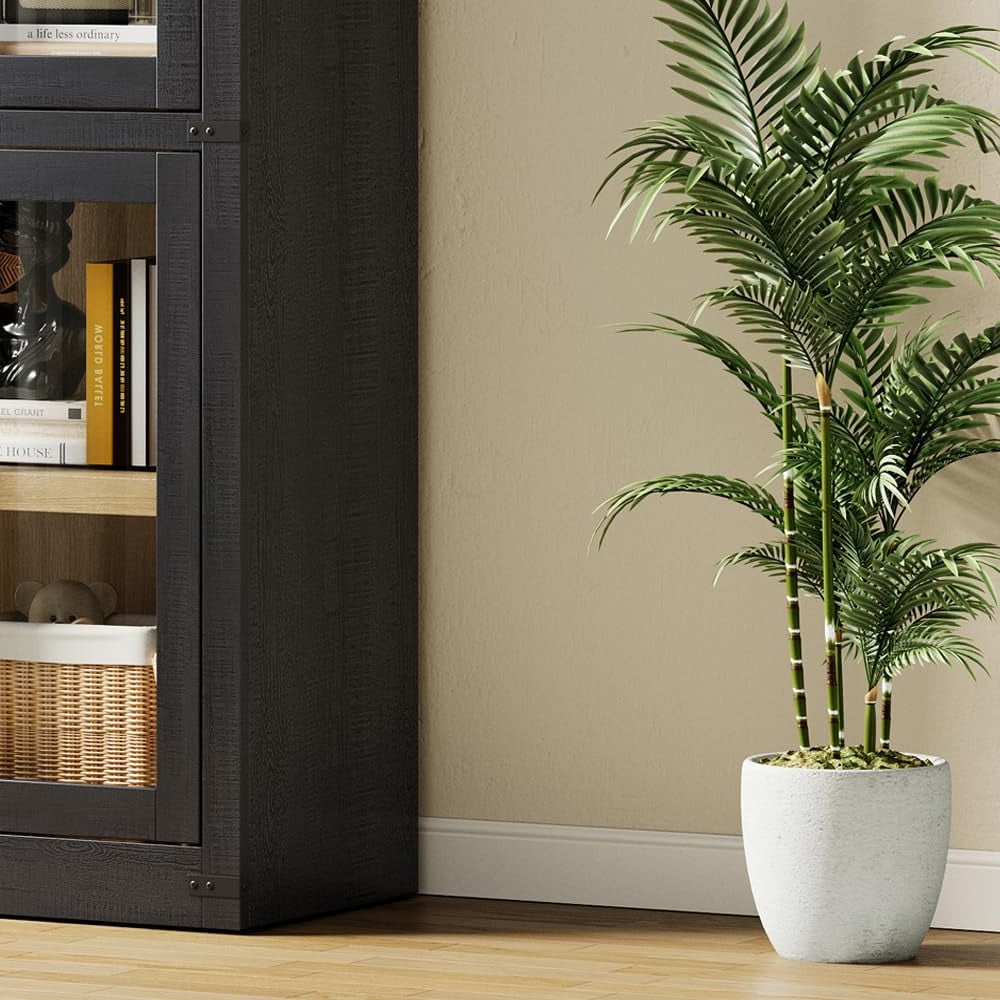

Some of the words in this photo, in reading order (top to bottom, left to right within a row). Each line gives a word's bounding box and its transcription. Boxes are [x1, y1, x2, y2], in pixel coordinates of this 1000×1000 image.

[27, 31, 33, 39] a
[36, 28, 53, 39] life
[55, 28, 73, 39] less
[76, 29, 120, 42] ordinary
[14, 408, 45, 417] GRANT
[6, 446, 53, 459] HOUSE
